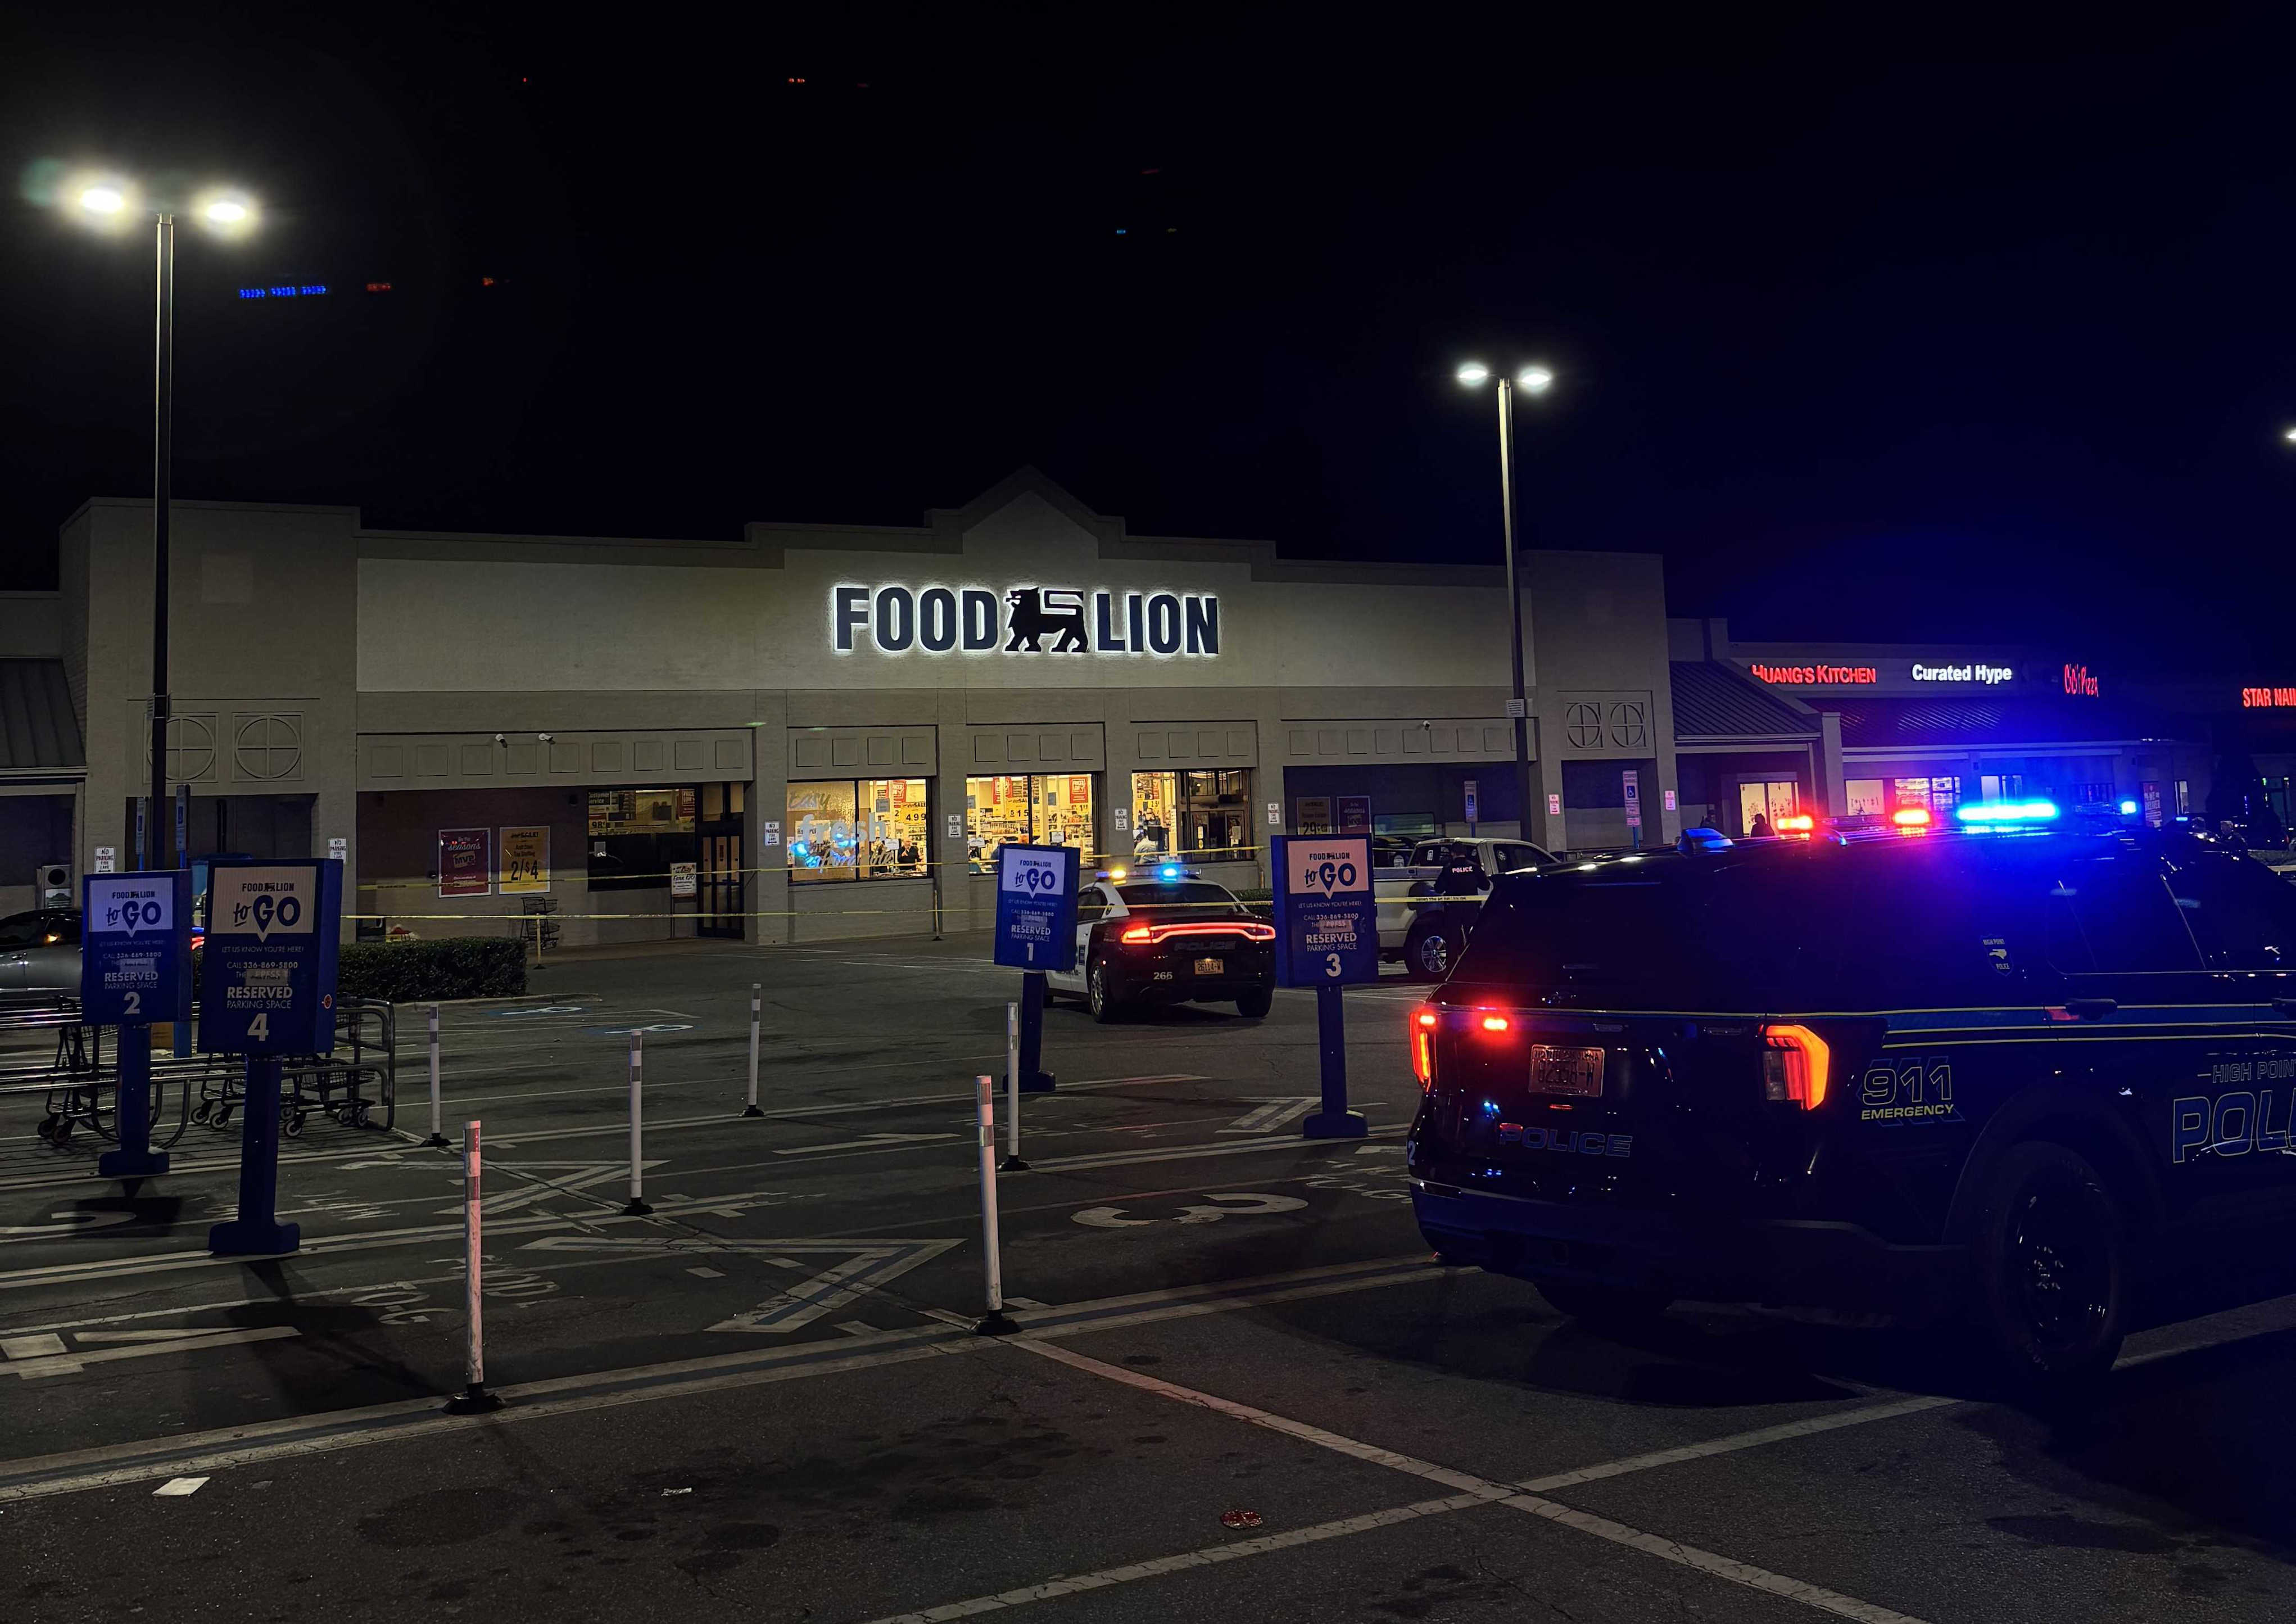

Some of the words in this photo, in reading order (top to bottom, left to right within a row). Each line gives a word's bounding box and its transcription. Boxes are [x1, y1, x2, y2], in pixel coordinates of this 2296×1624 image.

[835, 587, 998, 652] FOOD
[1096, 593, 1219, 654] LION
[1752, 664, 1815, 684] HUANG'S
[1817, 664, 1876, 684] KITCHEN
[1912, 664, 1971, 681] Curated
[1975, 664, 2012, 685] Hype
[2243, 687, 2272, 707] STAR
[800, 813, 886, 844] fresh
[511, 859, 538, 881] 2/$4
[1015, 872, 1025, 885] to
[1026, 868, 1056, 893] GO
[1305, 869, 1318, 885] to
[1319, 862, 1356, 892] GO
[112, 891, 130, 899] FOOD
[140, 890, 155, 899] LION
[242, 883, 264, 892] FOOD
[276, 883, 295, 892] LION
[107, 907, 120, 923] to
[122, 901, 161, 930] GO
[233, 903, 252, 924] to
[253, 895, 301, 933] GO
[1011, 924, 1051, 935] RESERVED
[1306, 932, 1357, 944] RESERVED
[1026, 942, 1034, 962] 1
[1172, 940, 1237, 952] POLICE
[1307, 943, 1335, 952] PARKING
[1325, 952, 1342, 978] 3
[104, 971, 158, 983] RESERVED
[123, 991, 141, 1015] 2
[227, 986, 293, 999] RESERVED
[227, 999, 264, 1009] PARKING
[266, 999, 292, 1009] SPACE
[247, 1012, 269, 1042] 4
[2212, 1062, 2252, 1084] HIGH
[1862, 1064, 1952, 1106] 911
[1861, 1103, 1954, 1120] EMERGENCY
[1497, 1123, 1633, 1159] POLICE
